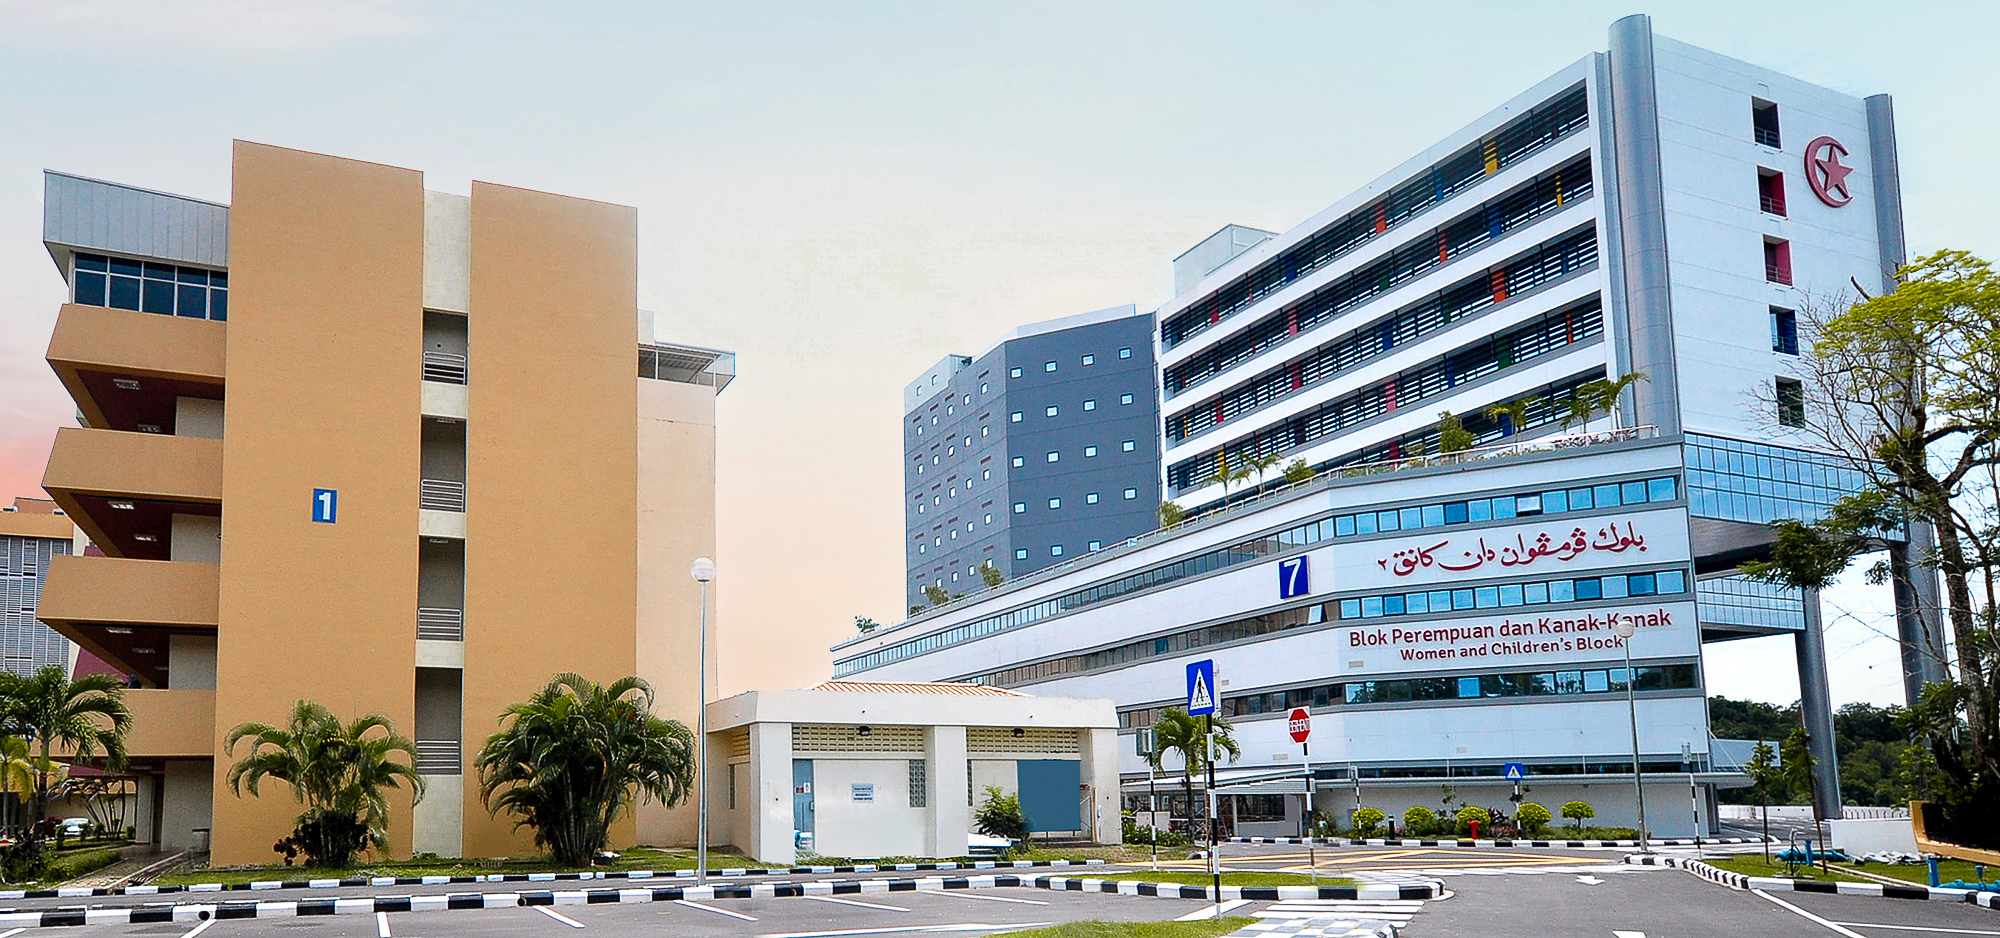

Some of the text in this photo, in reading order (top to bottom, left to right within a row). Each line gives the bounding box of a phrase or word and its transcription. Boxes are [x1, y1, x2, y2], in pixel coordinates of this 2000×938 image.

[318, 491, 331, 520] 1
[1437, 536, 1496, 572] دان
[1283, 558, 1302, 596] 7
[1349, 629, 1388, 647] Blok
[1392, 624, 1494, 644] Perempuan
[1499, 619, 1534, 637] dan
[1400, 648, 1456, 661] Women
[1459, 643, 1487, 657] and
[1576, 635, 1624, 650] Block
